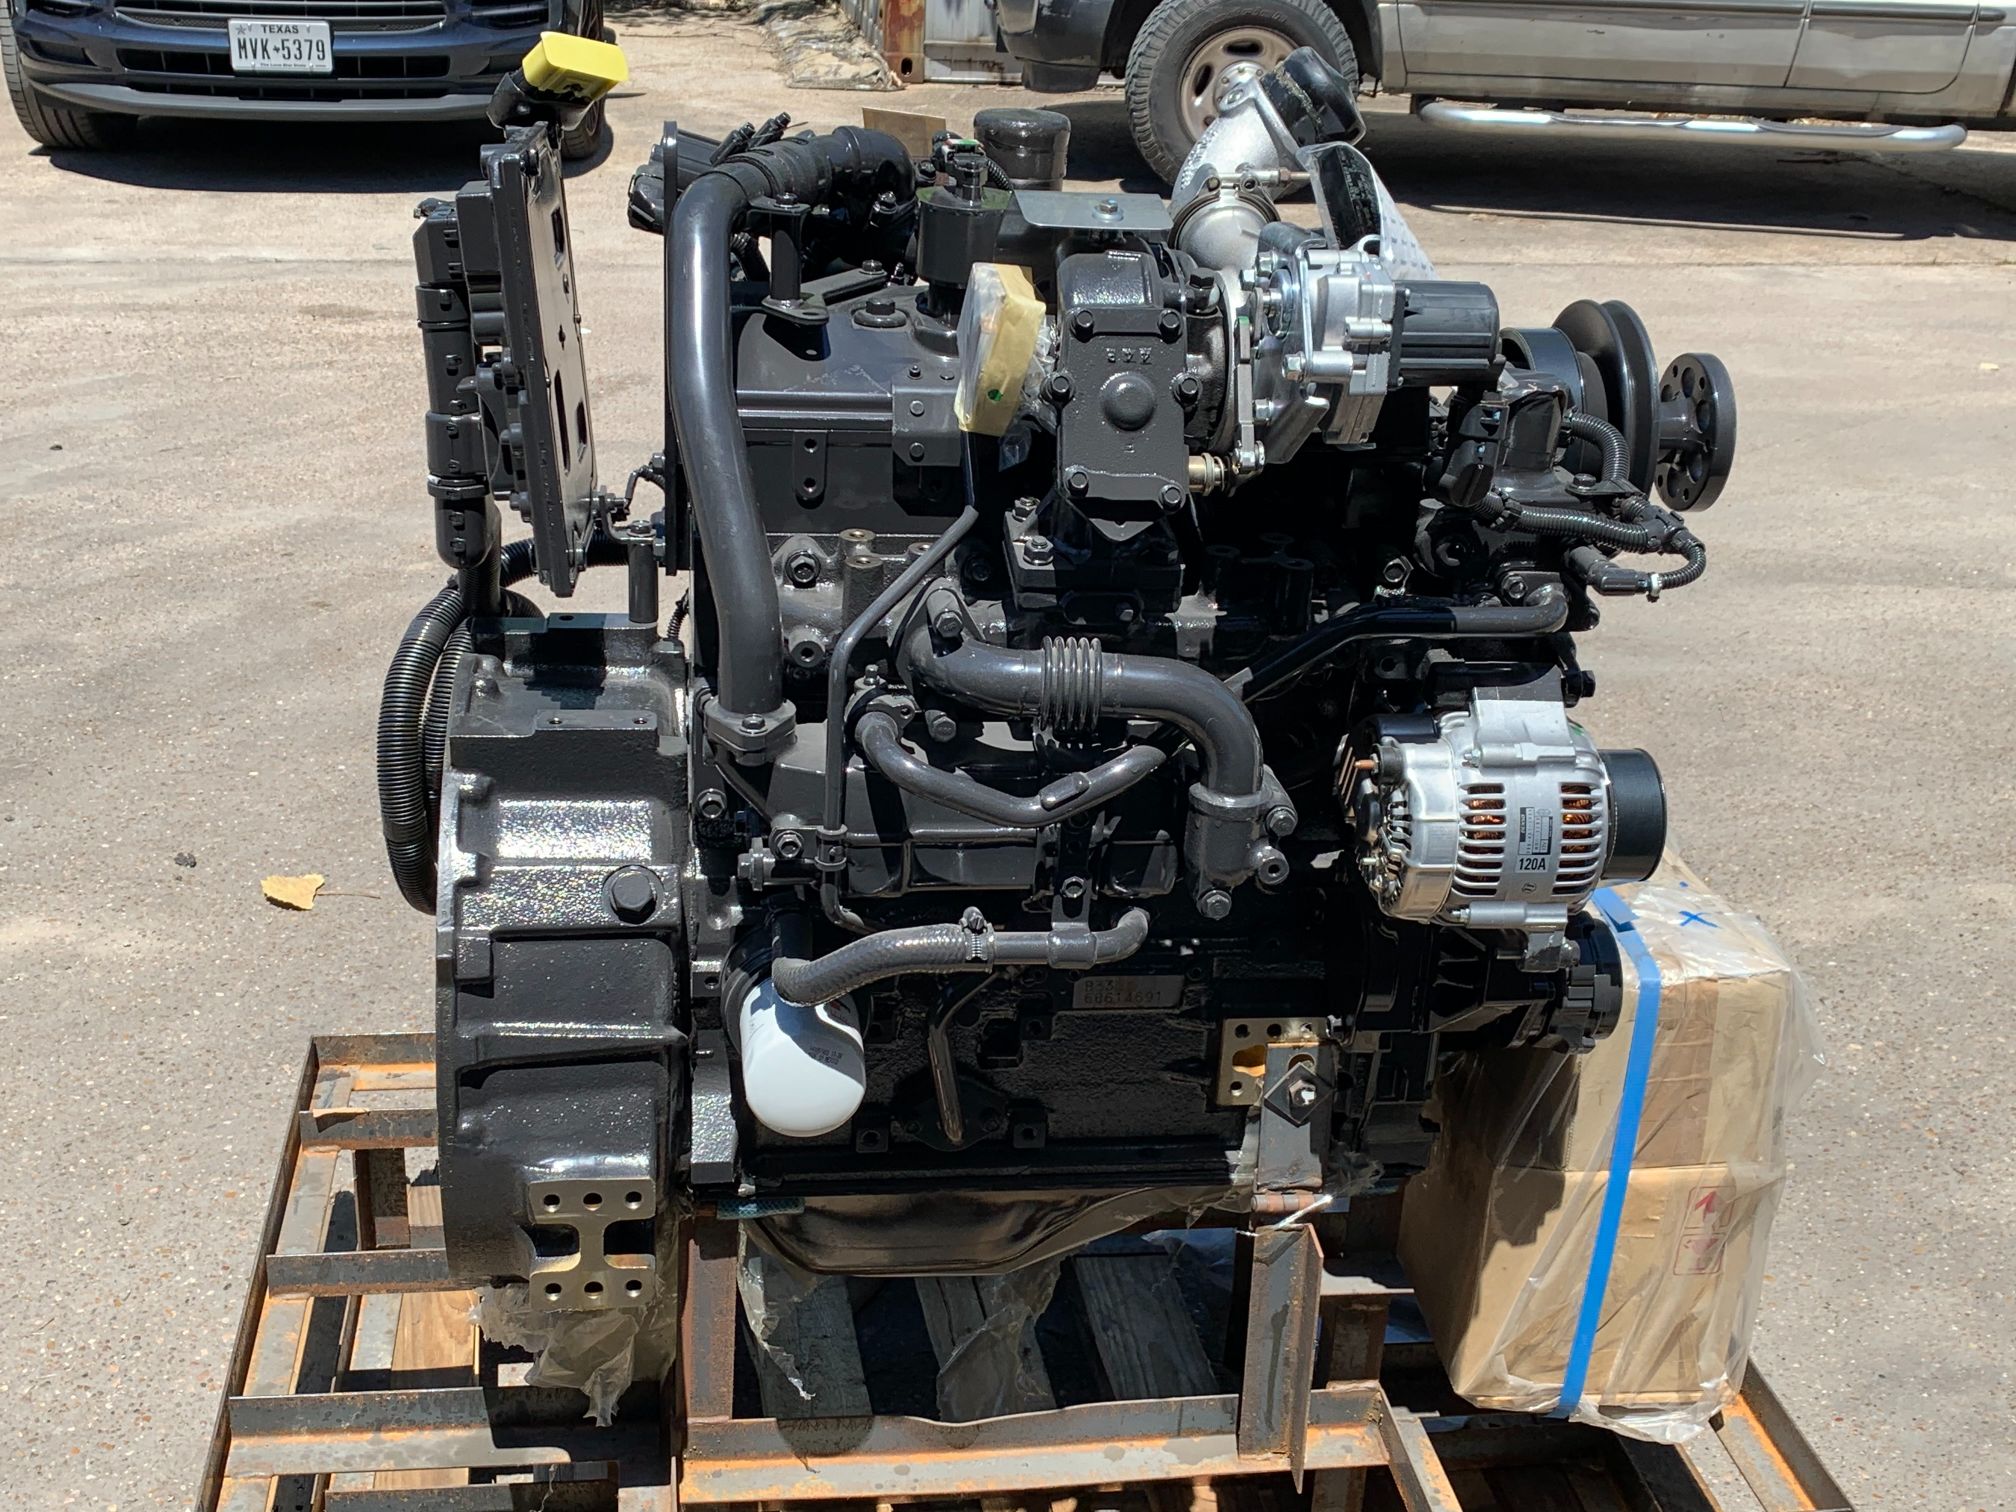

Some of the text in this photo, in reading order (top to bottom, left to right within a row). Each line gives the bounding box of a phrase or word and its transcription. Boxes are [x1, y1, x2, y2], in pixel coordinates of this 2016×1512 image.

[261, 24, 299, 34] TEXAS
[237, 38, 326, 61] MVK 5379
[1519, 857, 1546, 871] 120A
